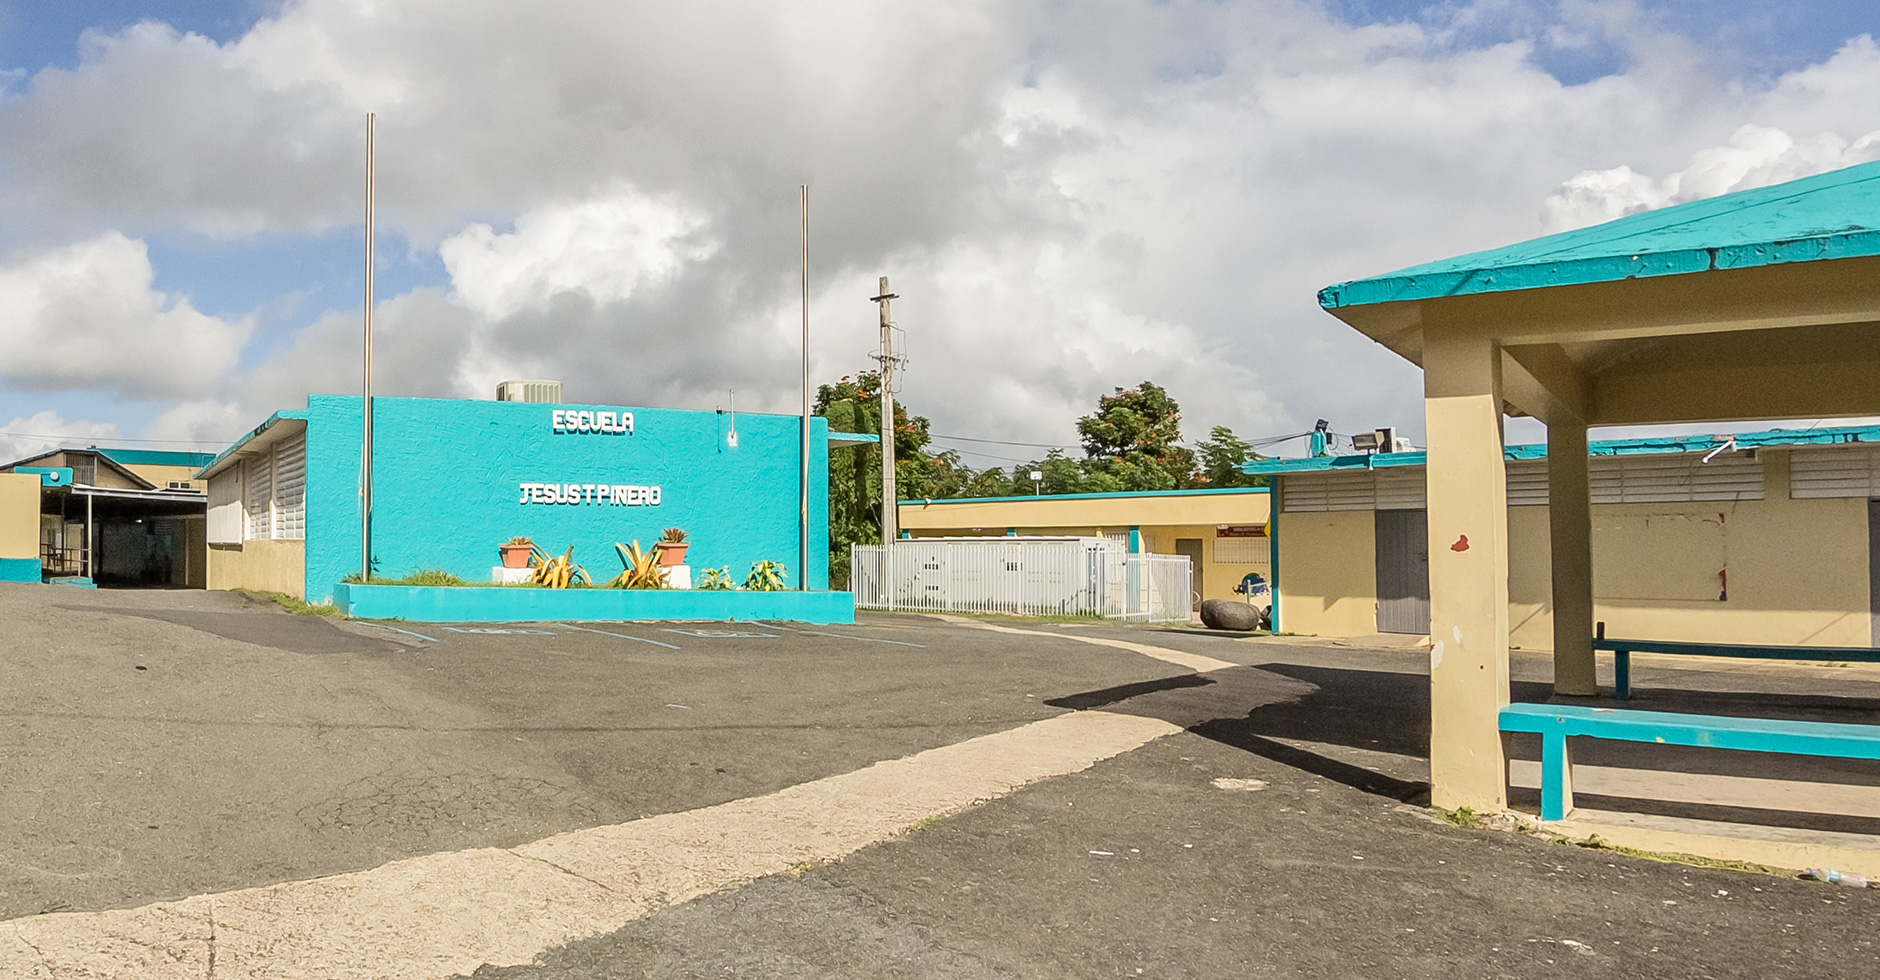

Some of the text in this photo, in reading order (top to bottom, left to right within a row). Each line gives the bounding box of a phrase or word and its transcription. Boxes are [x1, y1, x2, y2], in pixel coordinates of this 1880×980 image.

[552, 410, 634, 433] ESCUELA
[519, 483, 662, 505] JESUS T PINERO
